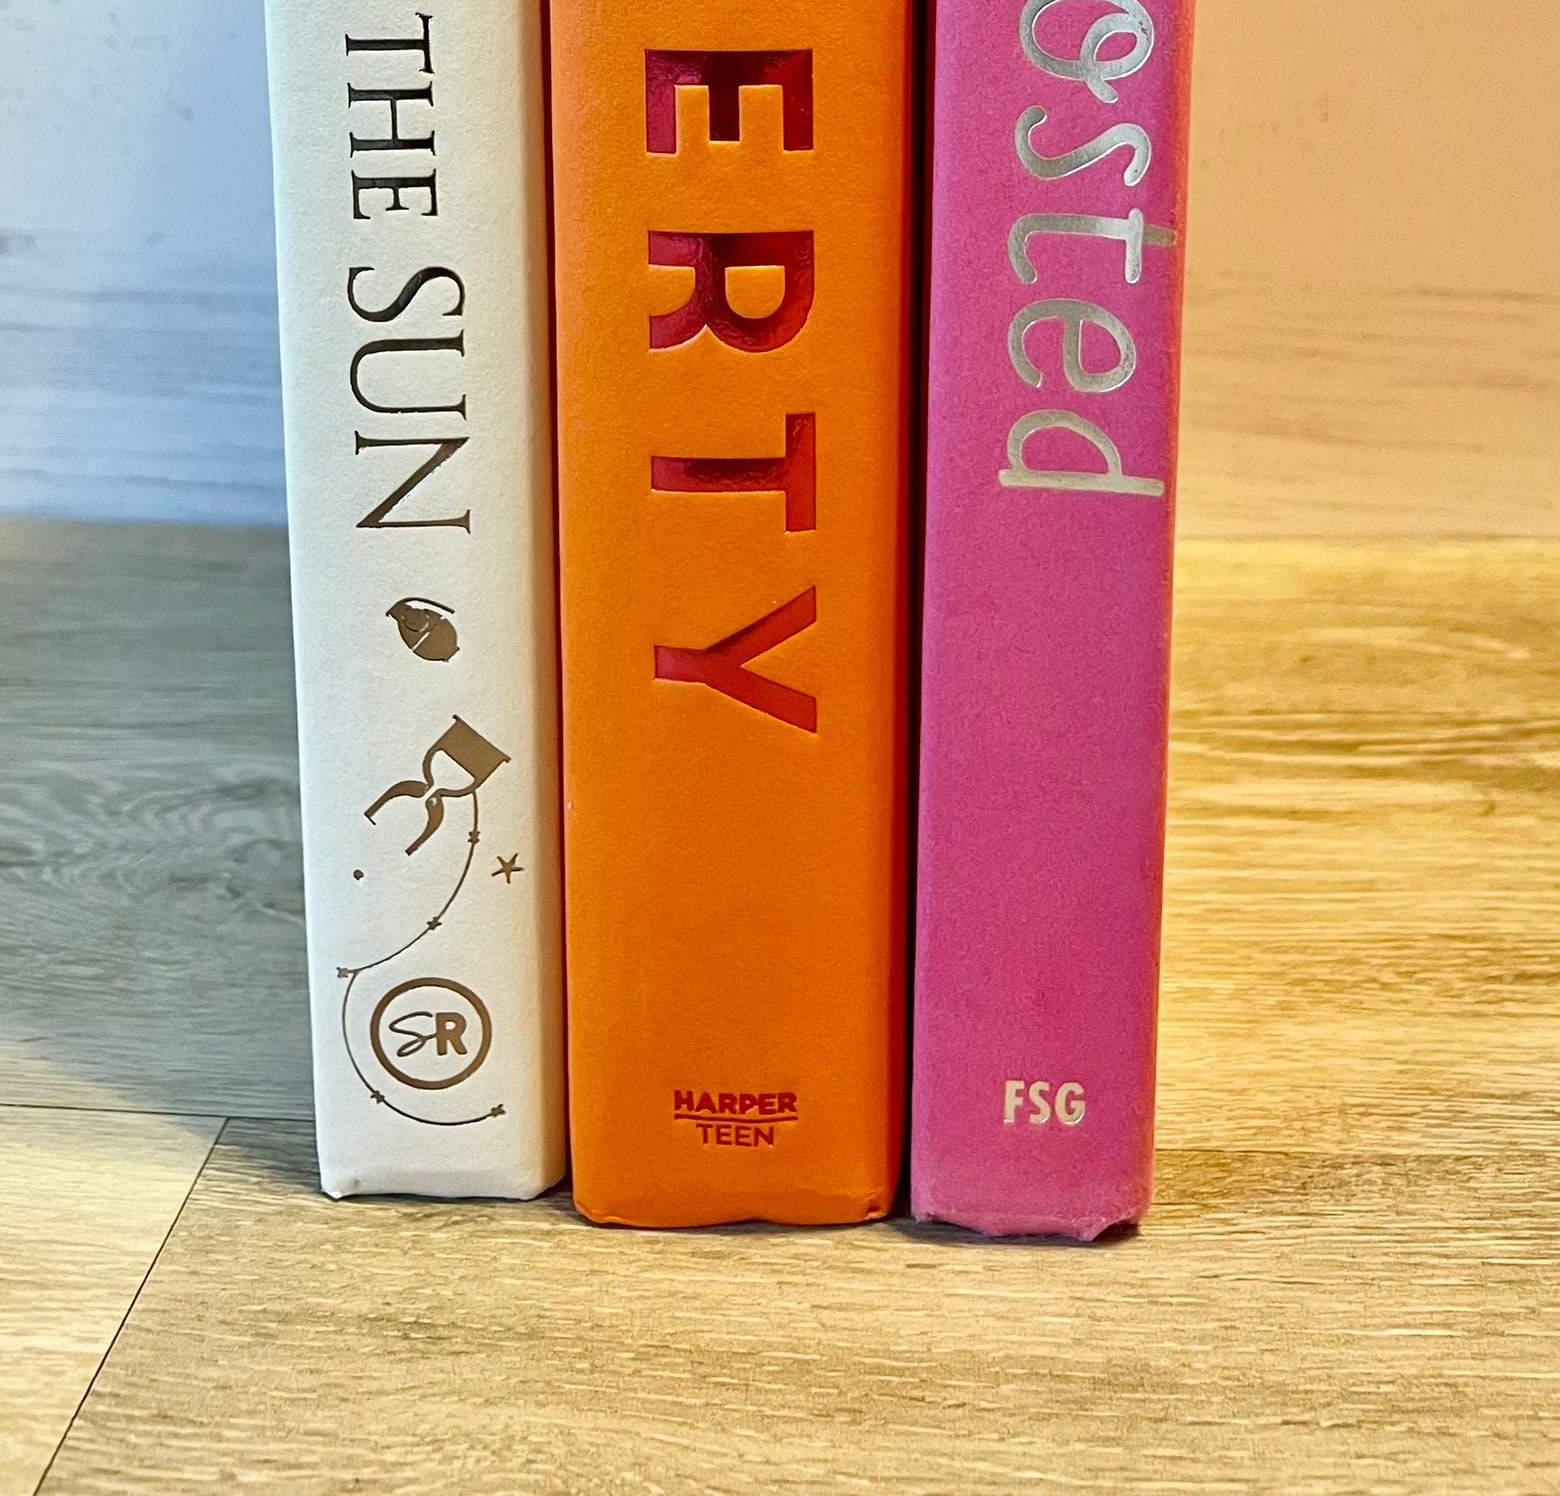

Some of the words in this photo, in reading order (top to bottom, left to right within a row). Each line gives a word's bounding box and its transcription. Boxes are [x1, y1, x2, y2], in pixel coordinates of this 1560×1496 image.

[344, 12, 439, 220] THE
[347, 265, 472, 535] SUN
[388, 1010, 468, 1058] SR
[674, 1090, 798, 1116] HARPER
[1003, 1080, 1086, 1126] FSG
[696, 1122, 775, 1147] TEEN
